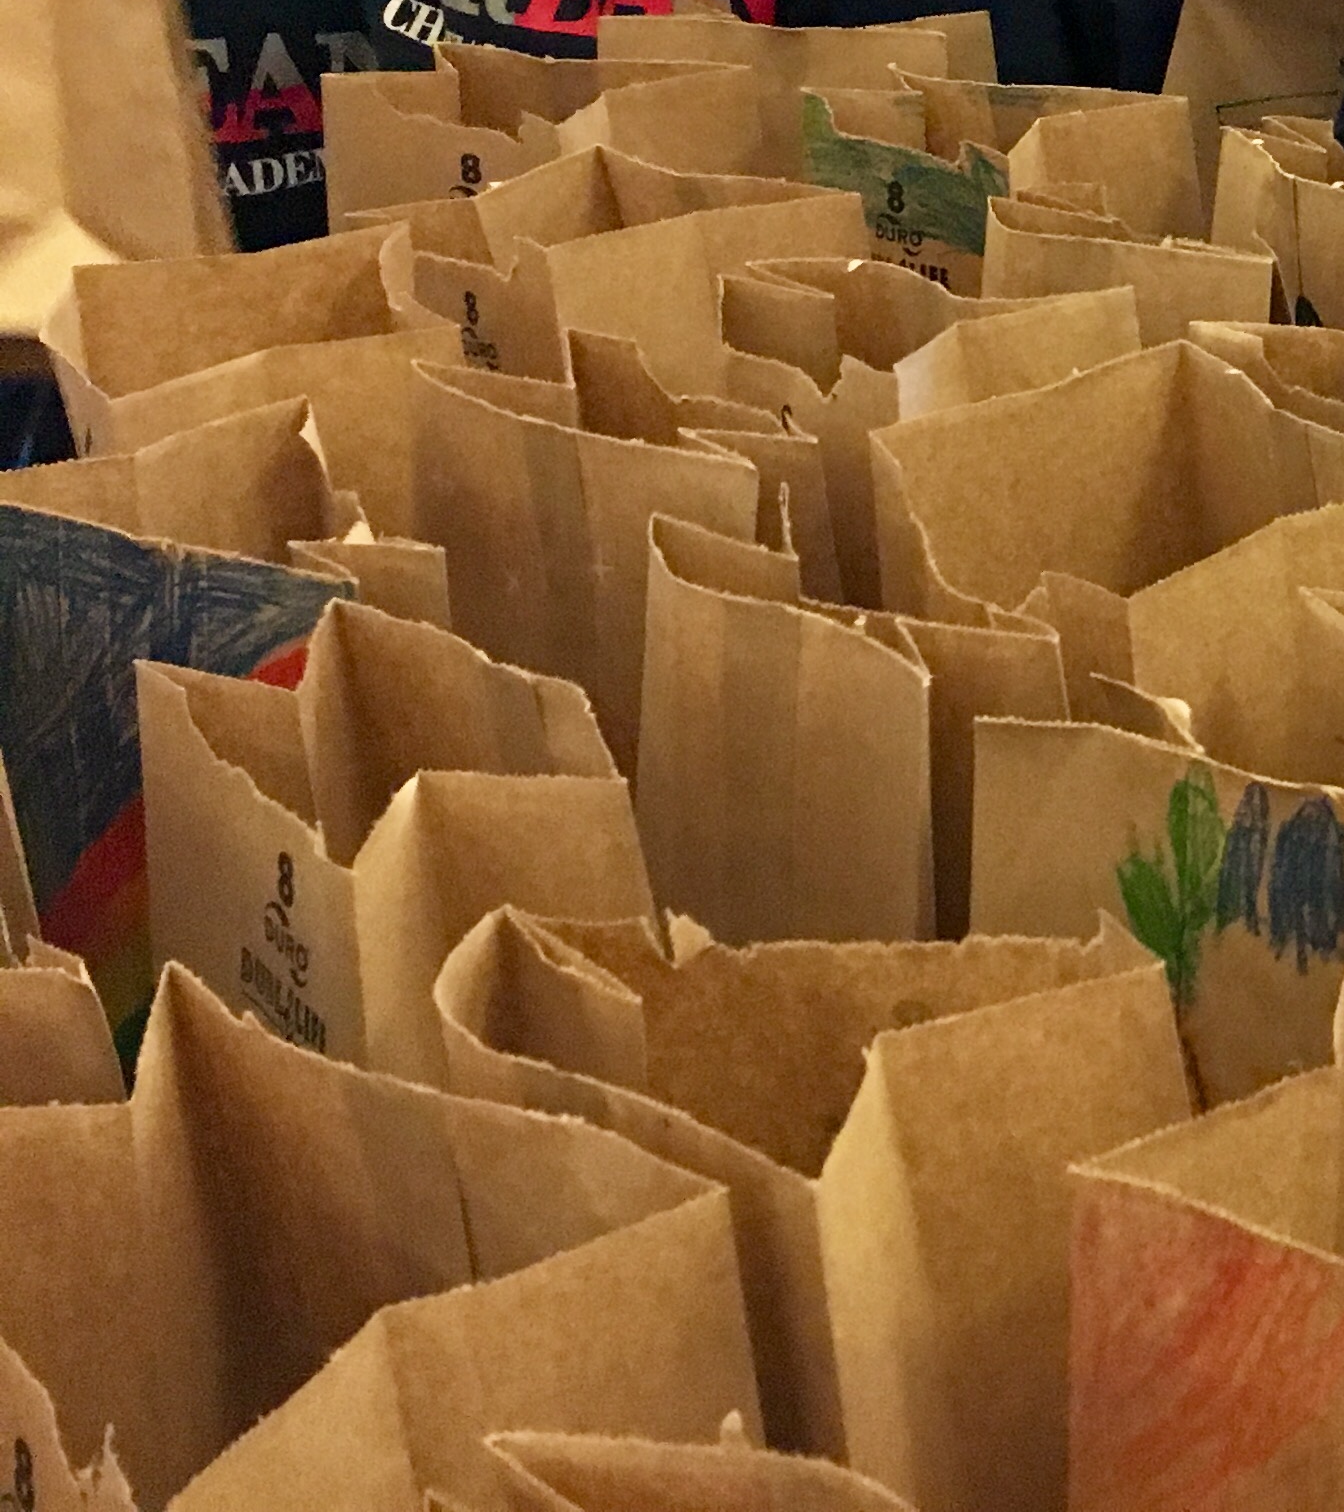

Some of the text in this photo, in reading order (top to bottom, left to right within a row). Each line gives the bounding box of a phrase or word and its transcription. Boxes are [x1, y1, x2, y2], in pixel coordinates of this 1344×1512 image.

[461, 153, 481, 184] 8
[887, 180, 904, 214] 8
[278, 851, 294, 908] 8
